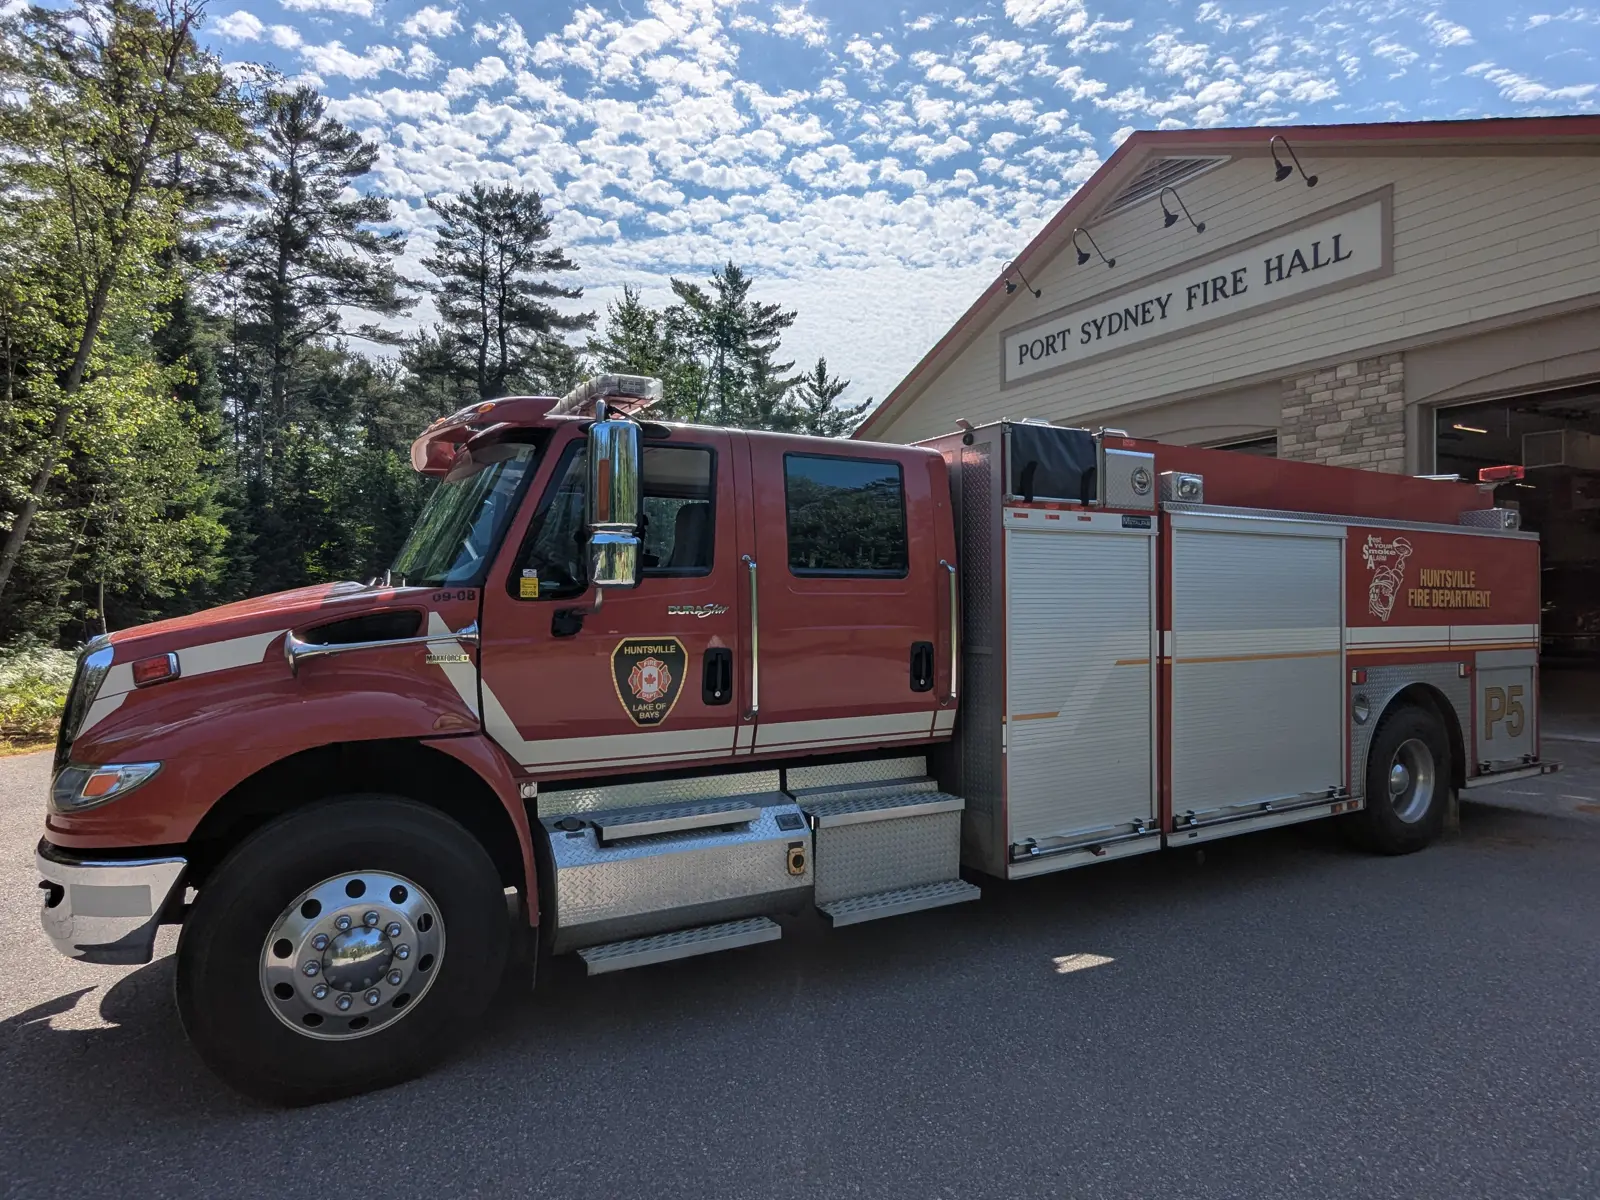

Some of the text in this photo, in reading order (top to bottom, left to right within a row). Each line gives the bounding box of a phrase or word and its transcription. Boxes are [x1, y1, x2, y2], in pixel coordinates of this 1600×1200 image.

[1017, 233, 1354, 366] PORT SYDNEY FIRE HALL
[1420, 568, 1476, 588] HUNTSVILLE
[1408, 588, 1492, 608] FIRE DEPARTMENT
[624, 645, 676, 655] HUNTSVILLE
[632, 702, 667, 712] LAKE OF
[639, 711, 660, 719] BAYS
[1484, 685, 1525, 741] P5
